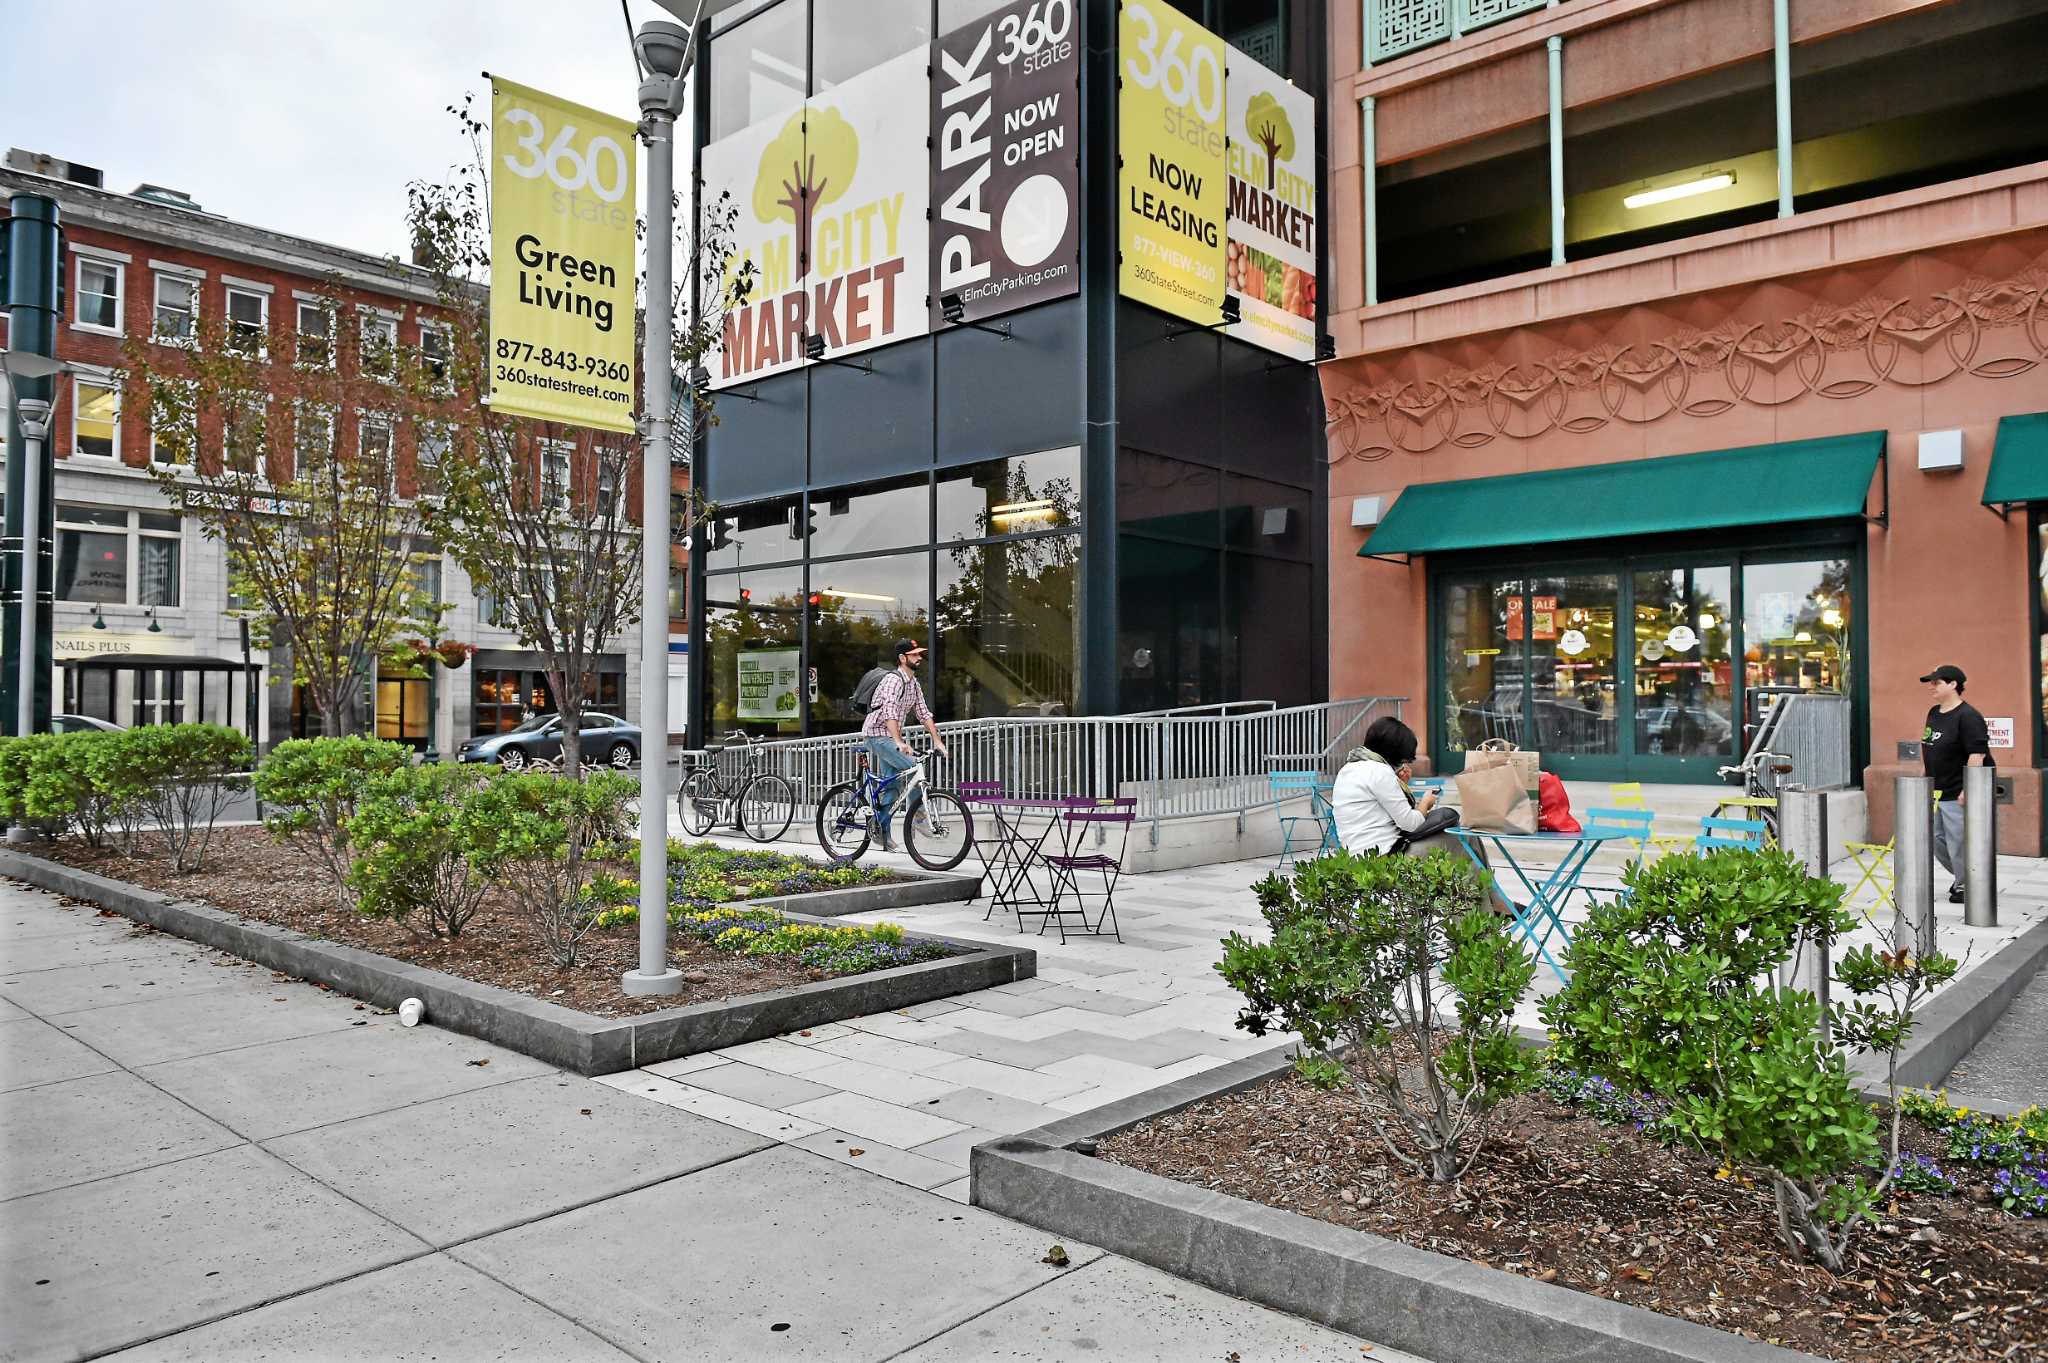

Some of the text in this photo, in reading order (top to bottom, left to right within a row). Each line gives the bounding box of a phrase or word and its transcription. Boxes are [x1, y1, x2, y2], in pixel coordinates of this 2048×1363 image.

[997, 0, 1072, 65] 360
[1023, 41, 1072, 75] state
[1127, 4, 1222, 124] 360
[1004, 93, 1060, 135] NOW
[1163, 106, 1222, 158] state
[503, 108, 628, 203] 360
[941, 23, 992, 292] PARK
[1003, 125, 1064, 166] OPEN
[1150, 153, 1202, 200] NOW
[1229, 141, 1313, 214] ELM CITY
[552, 190, 628, 230] state
[816, 192, 905, 278] CITY
[1131, 186, 1218, 248] LEASING
[1229, 174, 1314, 253] MARKET
[515, 234, 615, 288] Green
[1134, 264, 1216, 307] 360StateStreet.com
[519, 271, 613, 332] Living
[722, 257, 905, 379] MARKET
[496, 338, 629, 383] 877-843-9360
[496, 365, 630, 404] 360statestreet.com
[1532, 600, 1556, 610] ALE
[55, 640, 131, 653] NAILS PLUS
